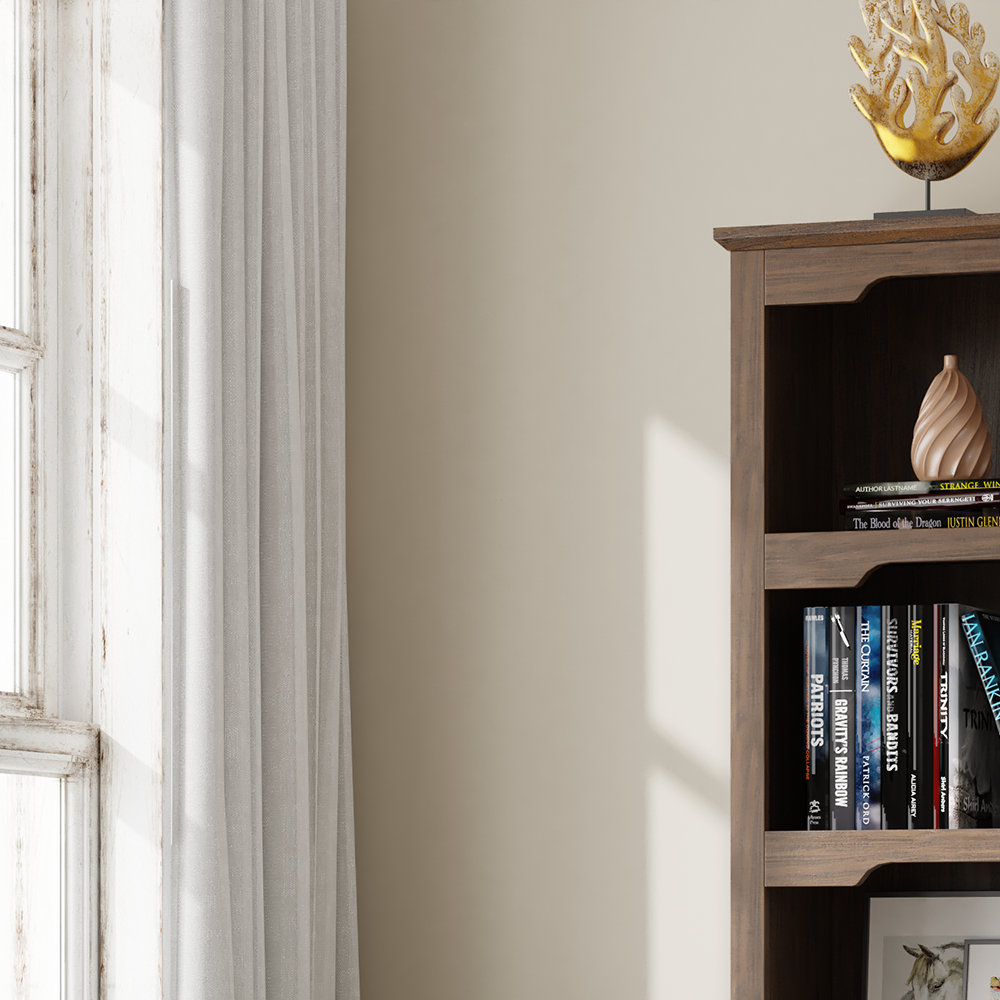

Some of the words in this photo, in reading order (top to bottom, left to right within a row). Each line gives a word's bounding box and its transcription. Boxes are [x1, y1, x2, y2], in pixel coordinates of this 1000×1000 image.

[940, 482, 979, 490] STRANGE
[852, 518, 868, 529] The
[870, 517, 890, 529] Blood
[892, 517, 900, 528] of
[901, 517, 913, 528] the
[915, 516, 942, 529] Dragon
[947, 517, 974, 528] JUSTIN
[861, 620, 870, 643] THE
[911, 620, 922, 665] Marriage
[961, 614, 984, 648] IAN
[861, 644, 871, 692] CURTAIN
[886, 618, 898, 693] SURVIVORS
[811, 674, 824, 747] PATRIOTS
[834, 699, 848, 754] GRAVITY'S
[886, 694, 894, 713] AND
[886, 713, 898, 772] BANDITS
[834, 756, 848, 808] RAINBOW
